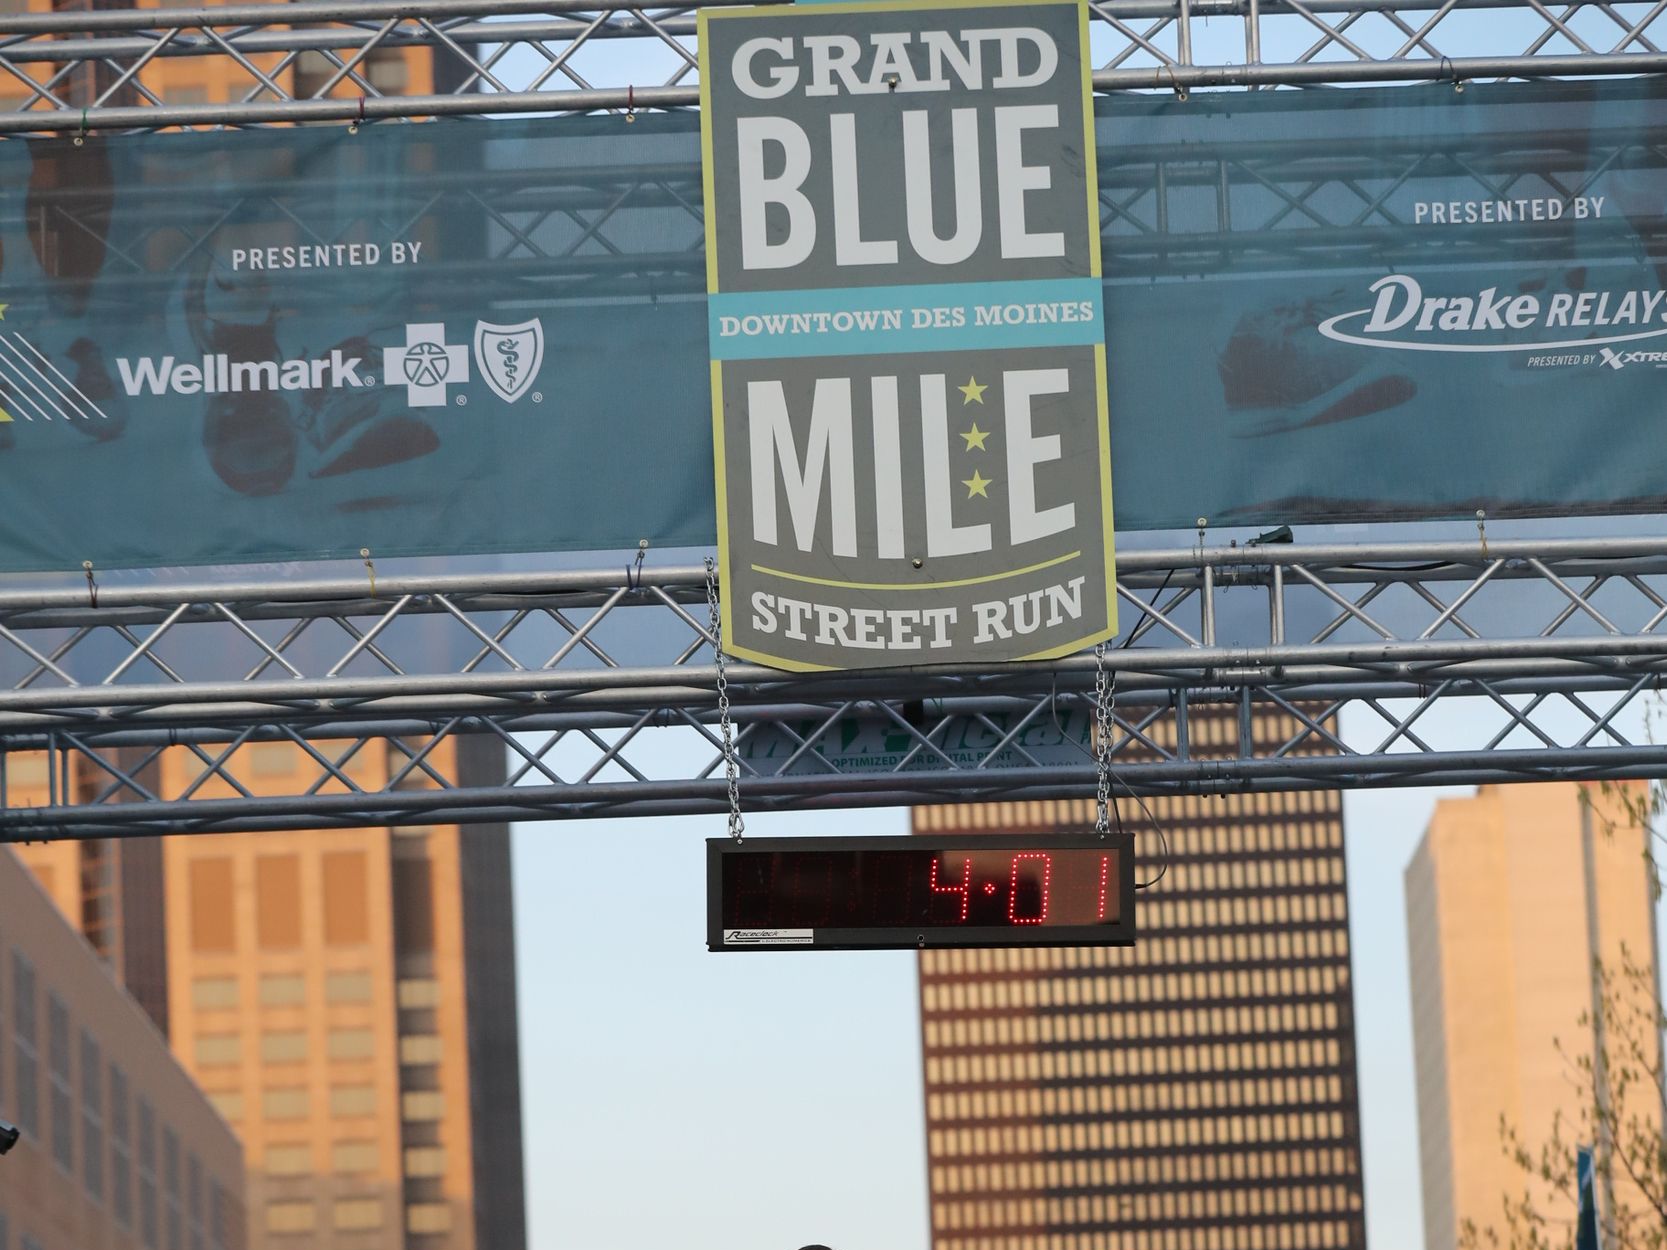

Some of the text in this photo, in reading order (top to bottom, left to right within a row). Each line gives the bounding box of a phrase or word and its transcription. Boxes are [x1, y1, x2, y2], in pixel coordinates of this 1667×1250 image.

[731, 27, 1059, 99] GRAND
[737, 104, 1065, 270] BLUE
[1414, 196, 1605, 224] PRESENTED BY
[232, 241, 423, 270] PRESENTED BY
[719, 302, 1094, 338] DOWNTOWN DES MOINES
[1363, 274, 1540, 333] Drake
[1527, 355, 1581, 367] PRESENTED
[1582, 354, 1597, 365] BY
[747, 368, 1076, 560] MILE
[750, 576, 1086, 650] STREET RUN
[831, 755, 897, 768] OPTIMIZED
